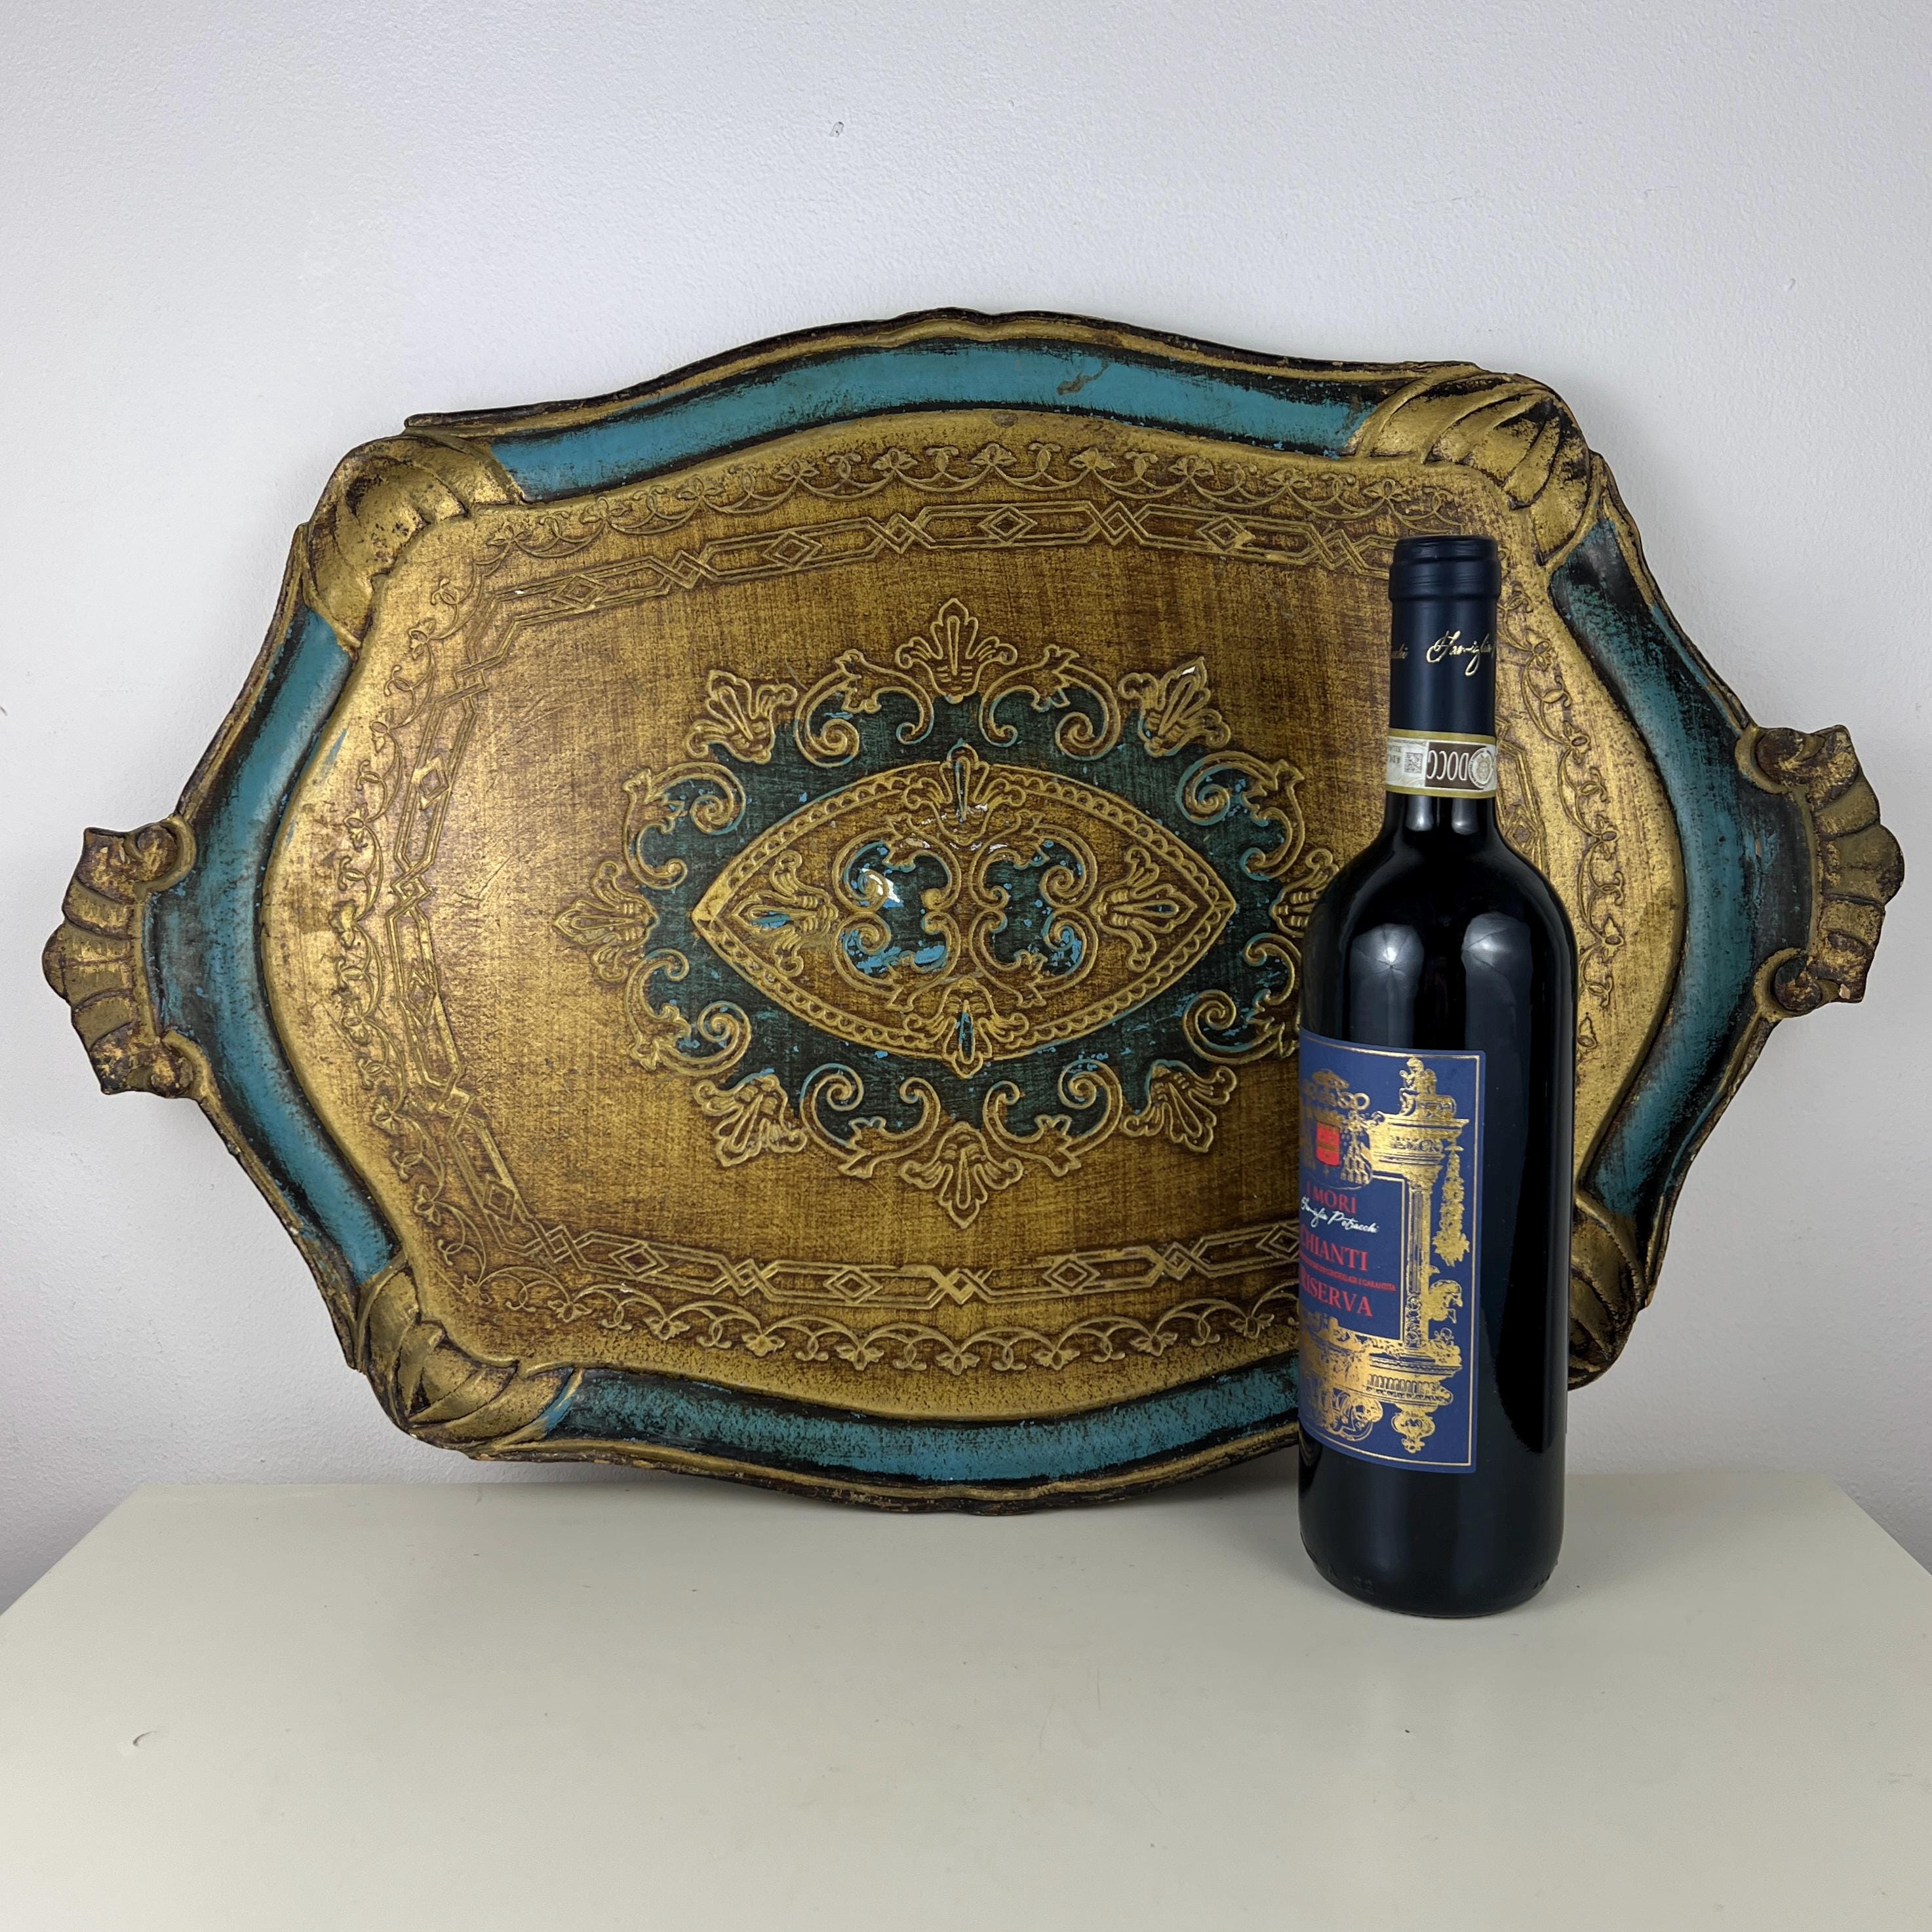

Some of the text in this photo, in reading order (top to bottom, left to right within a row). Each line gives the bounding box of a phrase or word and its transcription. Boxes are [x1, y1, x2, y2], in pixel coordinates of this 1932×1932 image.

[1313, 1185, 1356, 1214] MORI
[1300, 1224, 1369, 1272] CHIANTI
[1300, 1265, 1373, 1317] RISERVA
